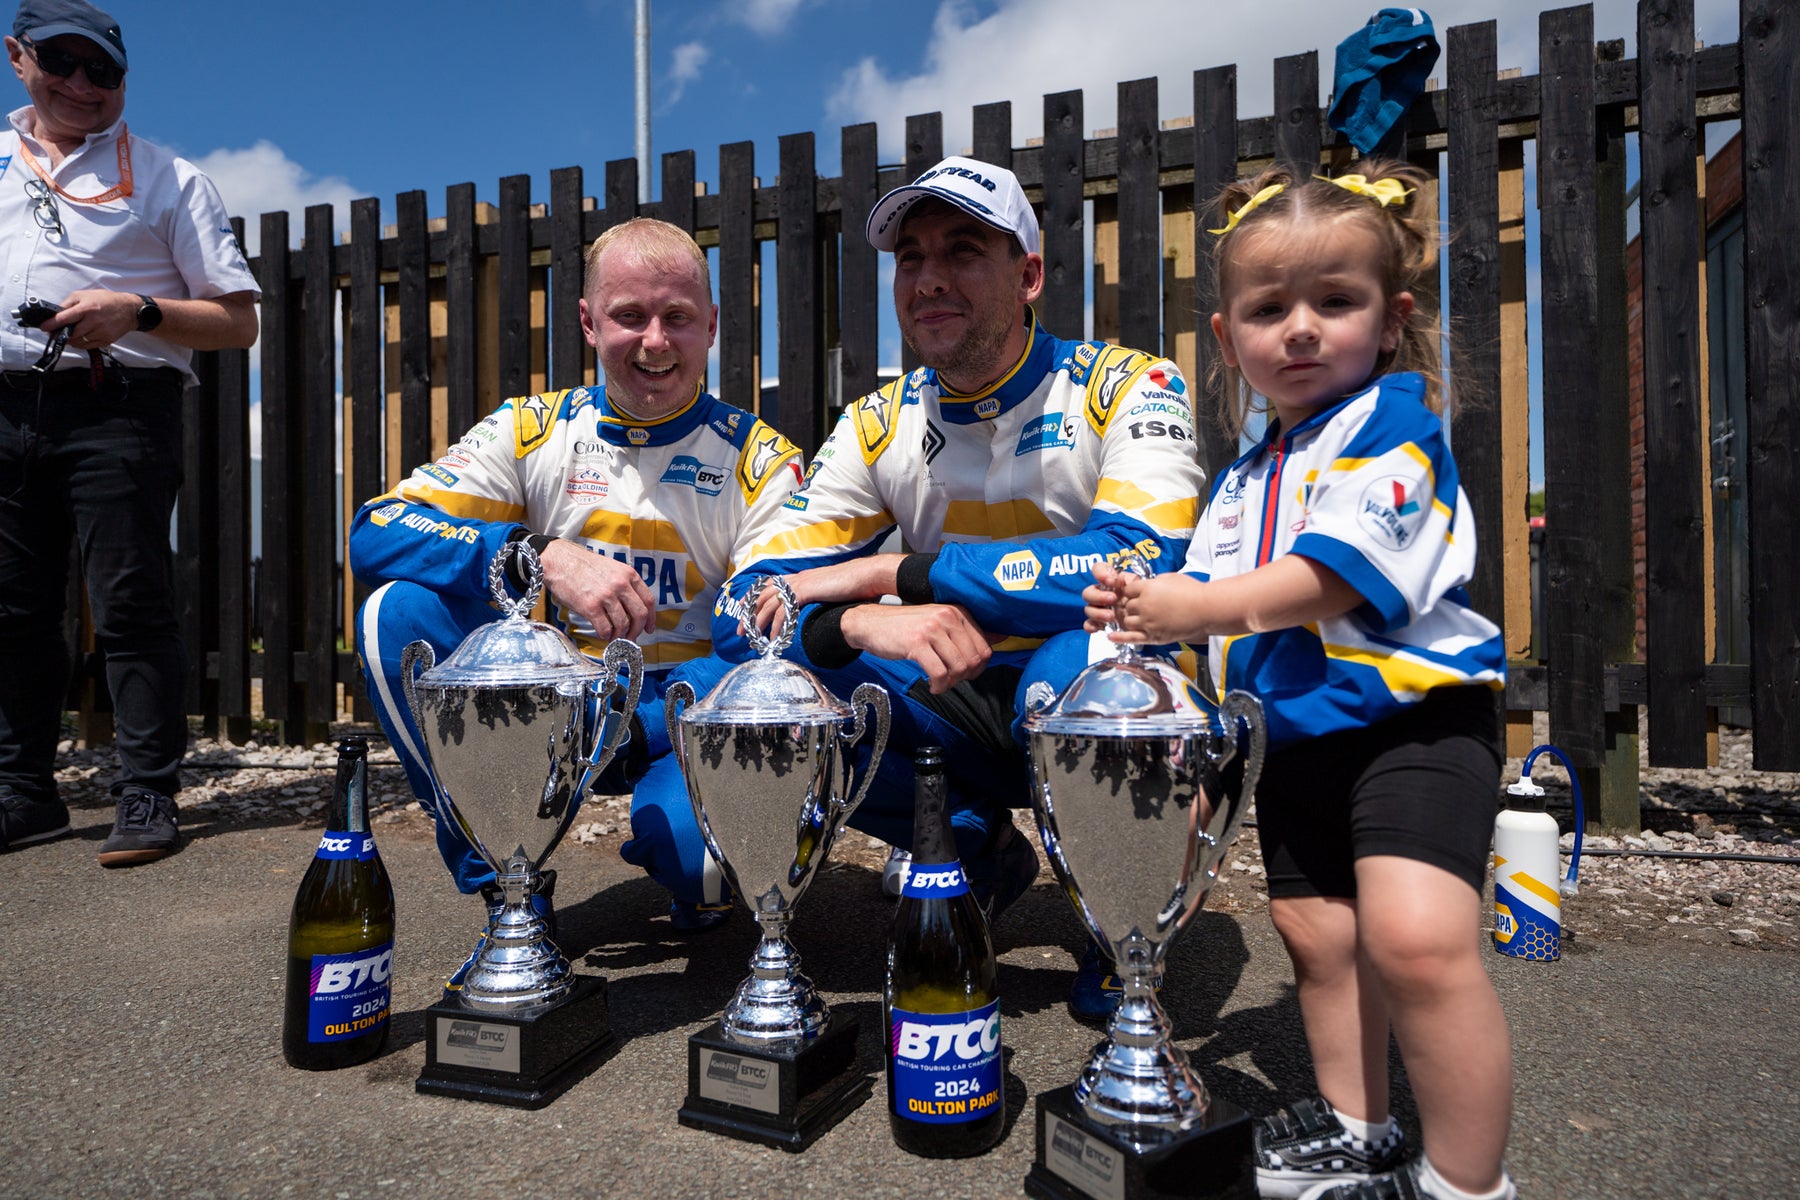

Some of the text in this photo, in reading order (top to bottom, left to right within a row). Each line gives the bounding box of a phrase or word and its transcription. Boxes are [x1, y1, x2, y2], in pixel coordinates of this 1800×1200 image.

[977, 401, 998, 414] NAPA
[630, 430, 647, 440] NAPA
[1002, 560, 1035, 582] NAPA
[1049, 553, 1104, 576] AUTO
[911, 869, 960, 889] BTCC
[341, 990, 367, 1000] TOURING
[353, 995, 386, 1018] 2024
[325, 1015, 376, 1036] OULTON
[481, 1031, 504, 1042] BTCC
[898, 1010, 999, 1062] BTCC
[741, 1065, 766, 1080] BTCC
[898, 1059, 919, 1070] BRITISH
[921, 1064, 950, 1072] TOURING
[952, 1063, 967, 1071] CAR
[934, 1077, 980, 1097] 2024
[908, 1088, 999, 1116] OULTON PARK
[1086, 1144, 1112, 1169] BTCC
